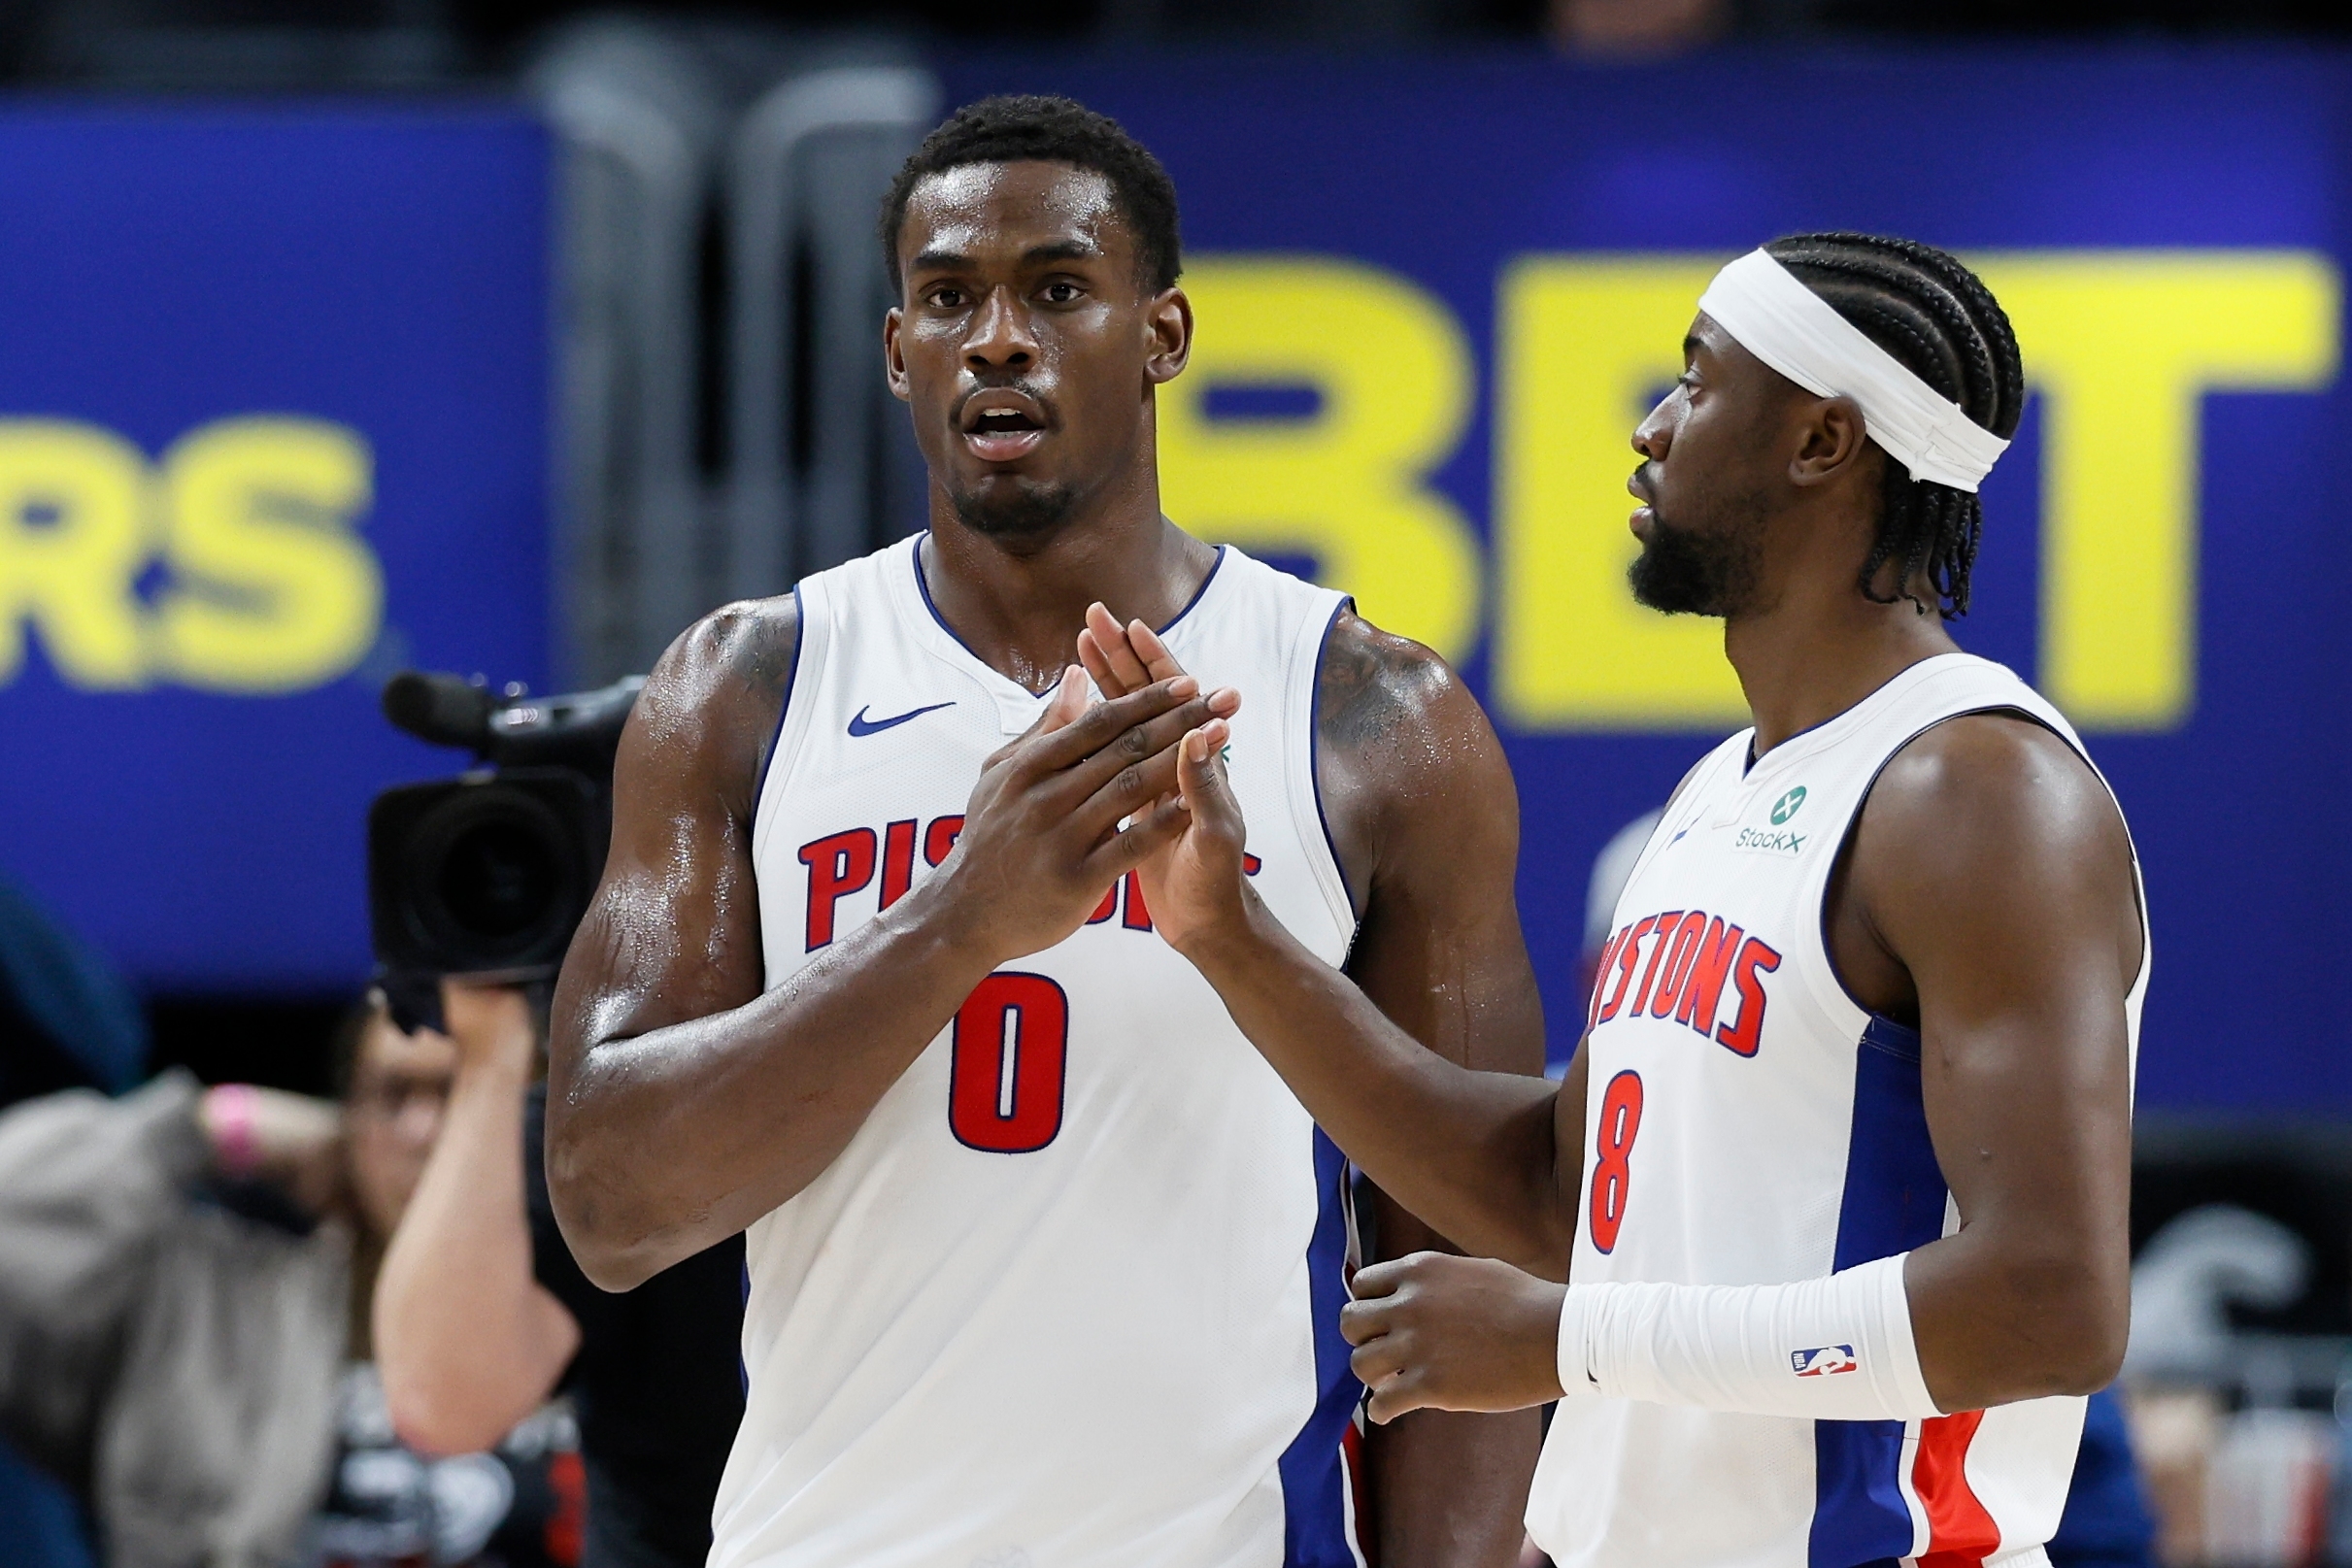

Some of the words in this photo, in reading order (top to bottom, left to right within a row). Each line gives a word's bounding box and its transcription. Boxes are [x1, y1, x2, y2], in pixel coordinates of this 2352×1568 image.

[1155, 250, 2342, 730] BET
[1735, 827, 1808, 853] StockX
[948, 971, 1068, 1155] 0
[1589, 1068, 1643, 1255] 8
